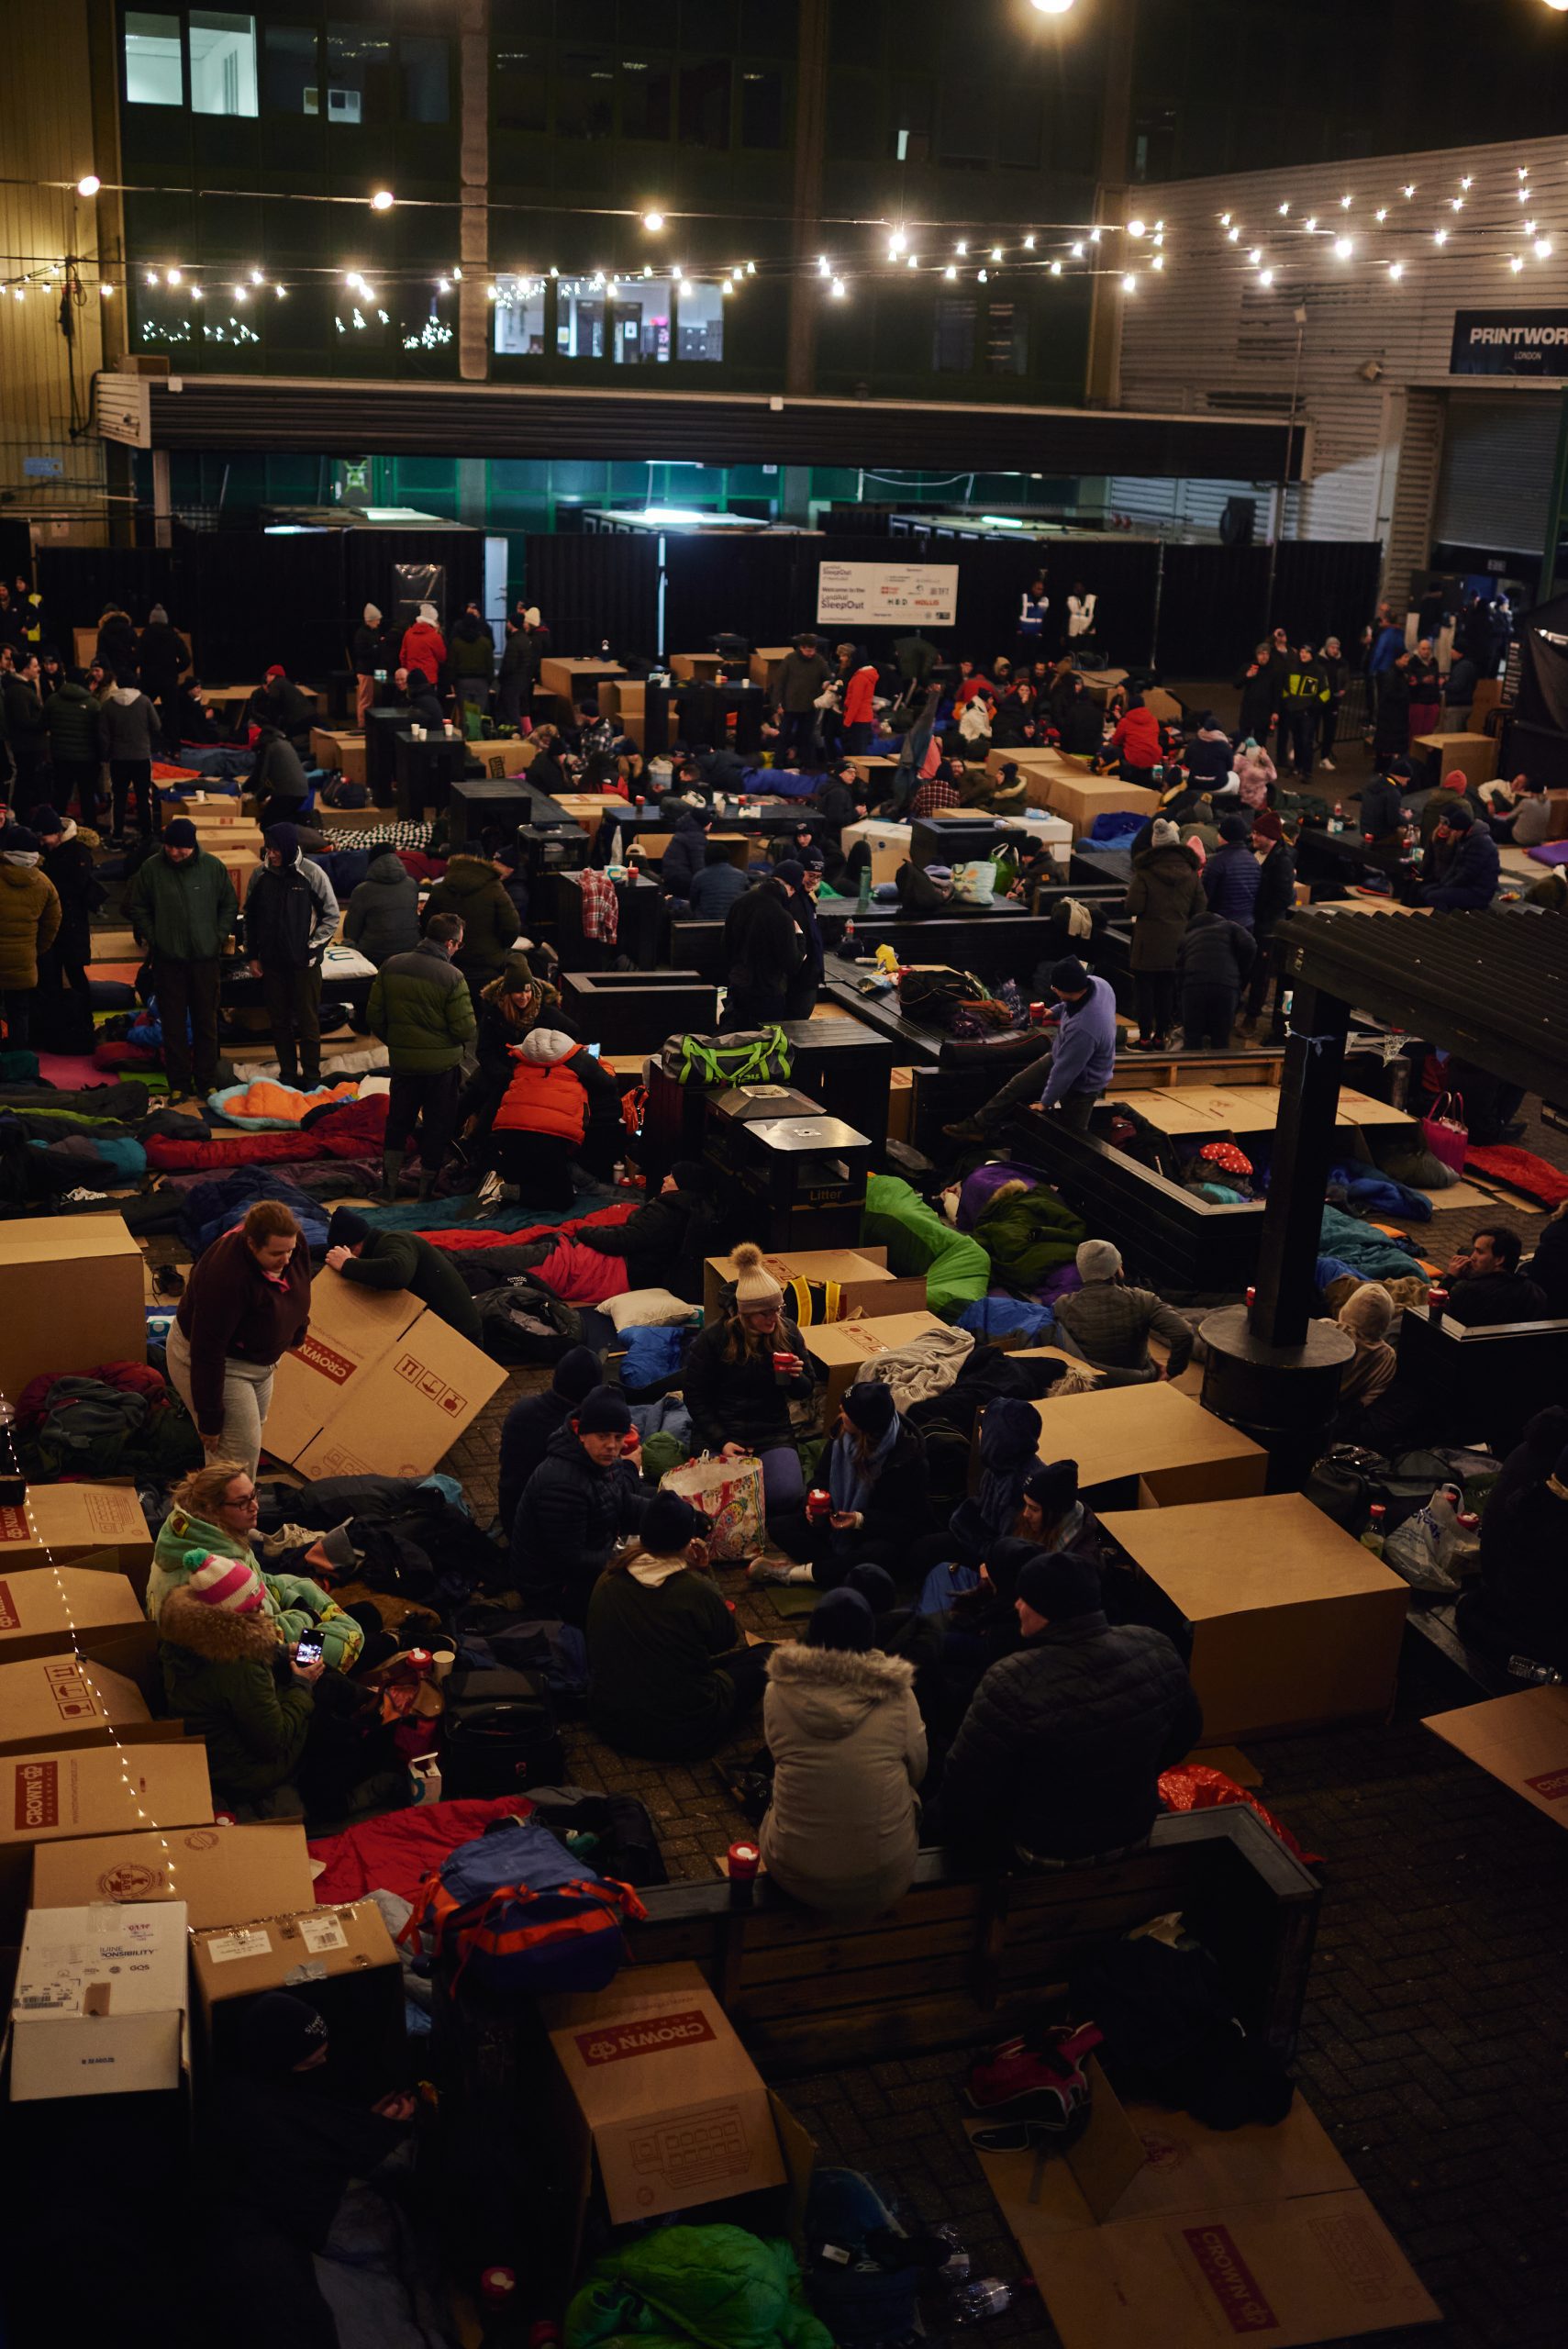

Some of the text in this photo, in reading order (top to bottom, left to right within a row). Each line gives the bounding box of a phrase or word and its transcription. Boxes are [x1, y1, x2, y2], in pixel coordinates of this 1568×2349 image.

[1470, 328, 1568, 345] PRINTWOR
[1513, 351, 1542, 361] LONDON
[821, 599, 864, 610] SleepOut
[808, 1188, 843, 1201] Litter
[297, 1342, 347, 1377] CROWN
[26, 1780, 43, 1826] CROWN
[617, 2021, 706, 2051] CROWN
[1202, 2231, 1251, 2300] CROWN
